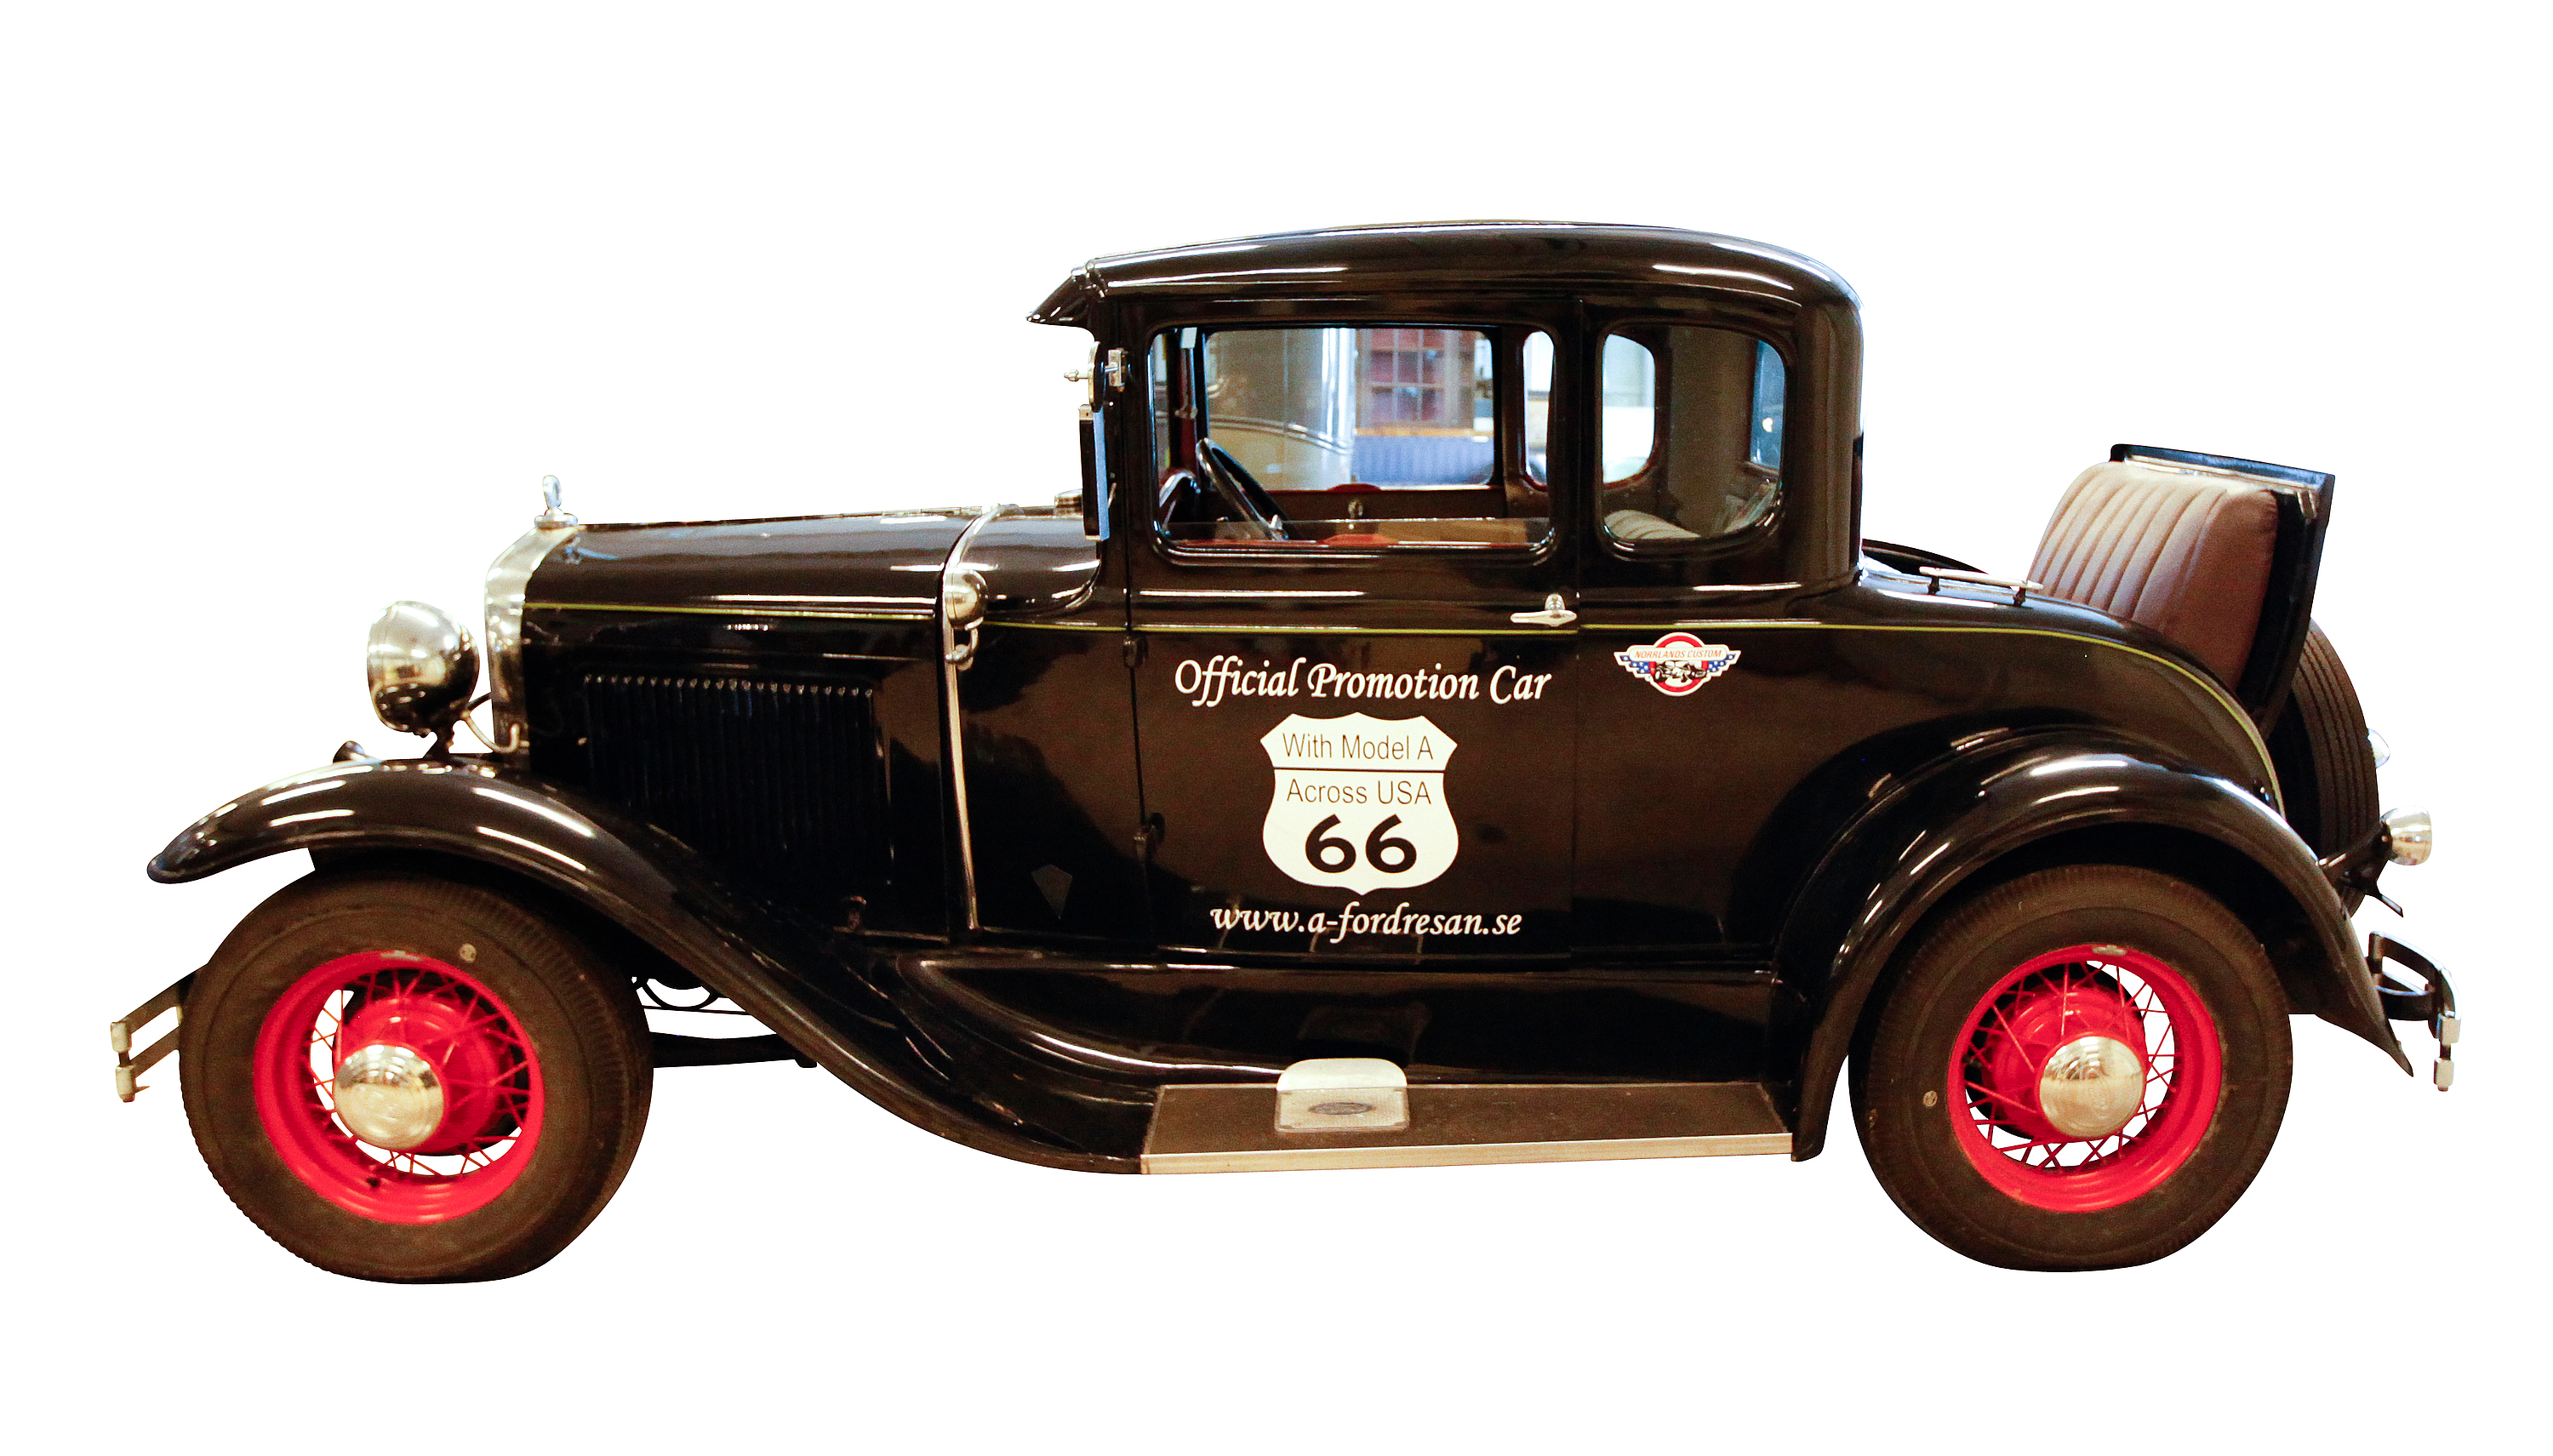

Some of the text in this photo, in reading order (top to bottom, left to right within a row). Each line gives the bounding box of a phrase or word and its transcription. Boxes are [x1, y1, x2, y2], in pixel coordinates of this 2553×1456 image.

[1635, 649, 1722, 659] NORRLANDS CUSTOM
[1174, 654, 1552, 707] Official Promotion Car
[1282, 732, 1434, 761] With Model A
[1286, 778, 1432, 805] Across USA
[1305, 814, 1417, 874] 66
[1209, 901, 1522, 944] www.a-fordresan.se
